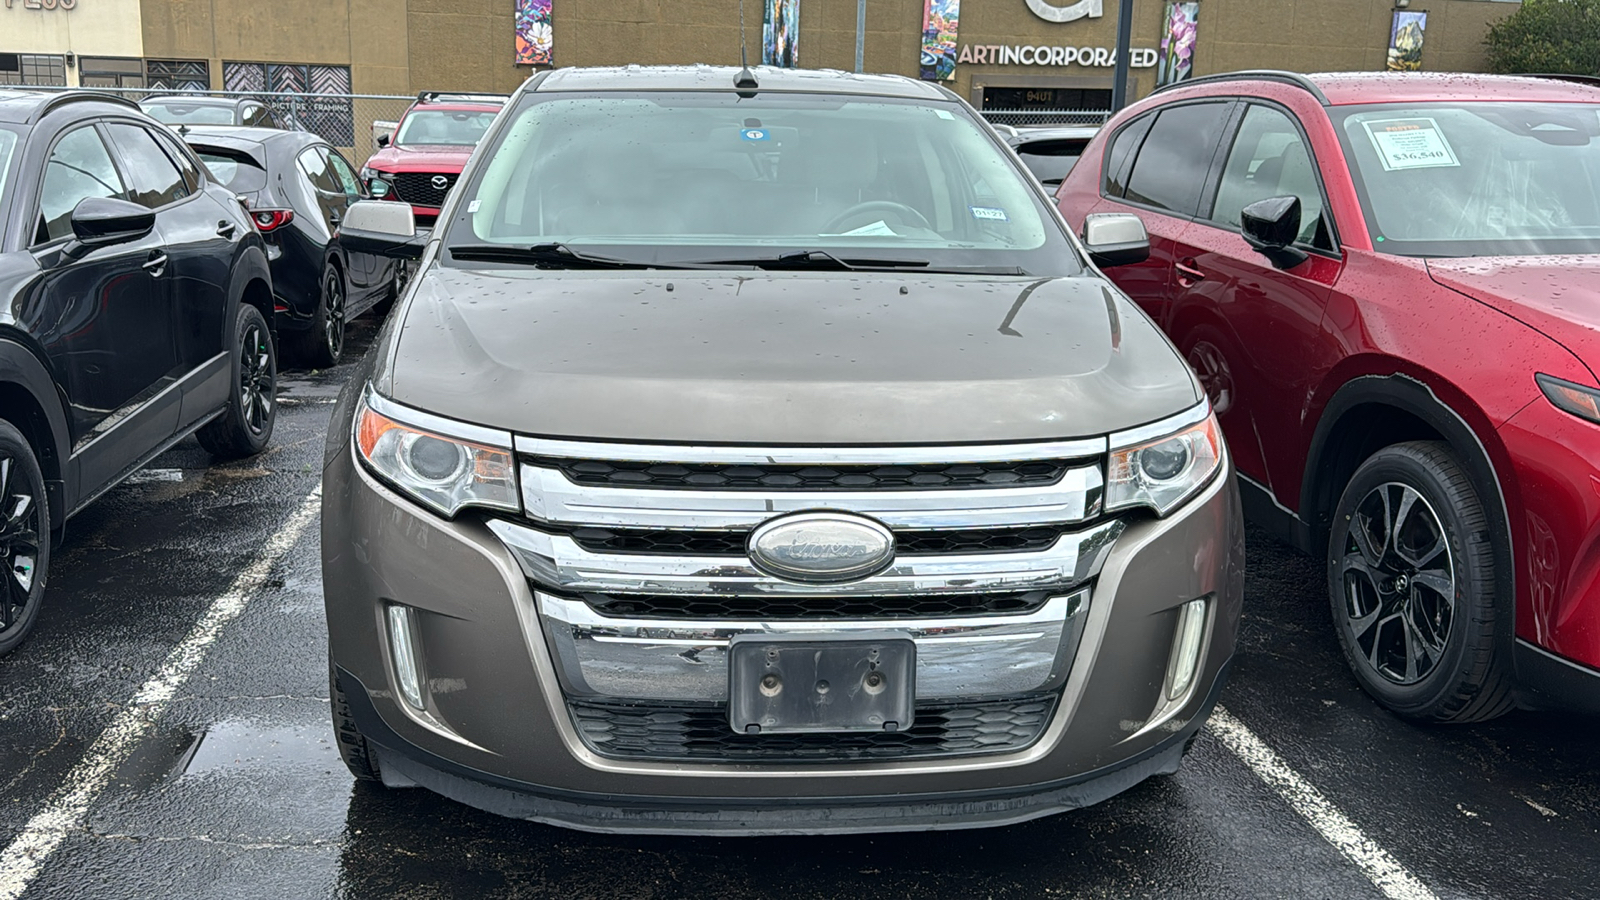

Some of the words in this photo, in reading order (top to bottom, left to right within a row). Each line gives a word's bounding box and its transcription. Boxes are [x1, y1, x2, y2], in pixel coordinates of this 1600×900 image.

[958, 44, 1158, 68] ARTINCORPORAED
[314, 103, 349, 112] FRAMING
[1393, 150, 1444, 161] $36,540
